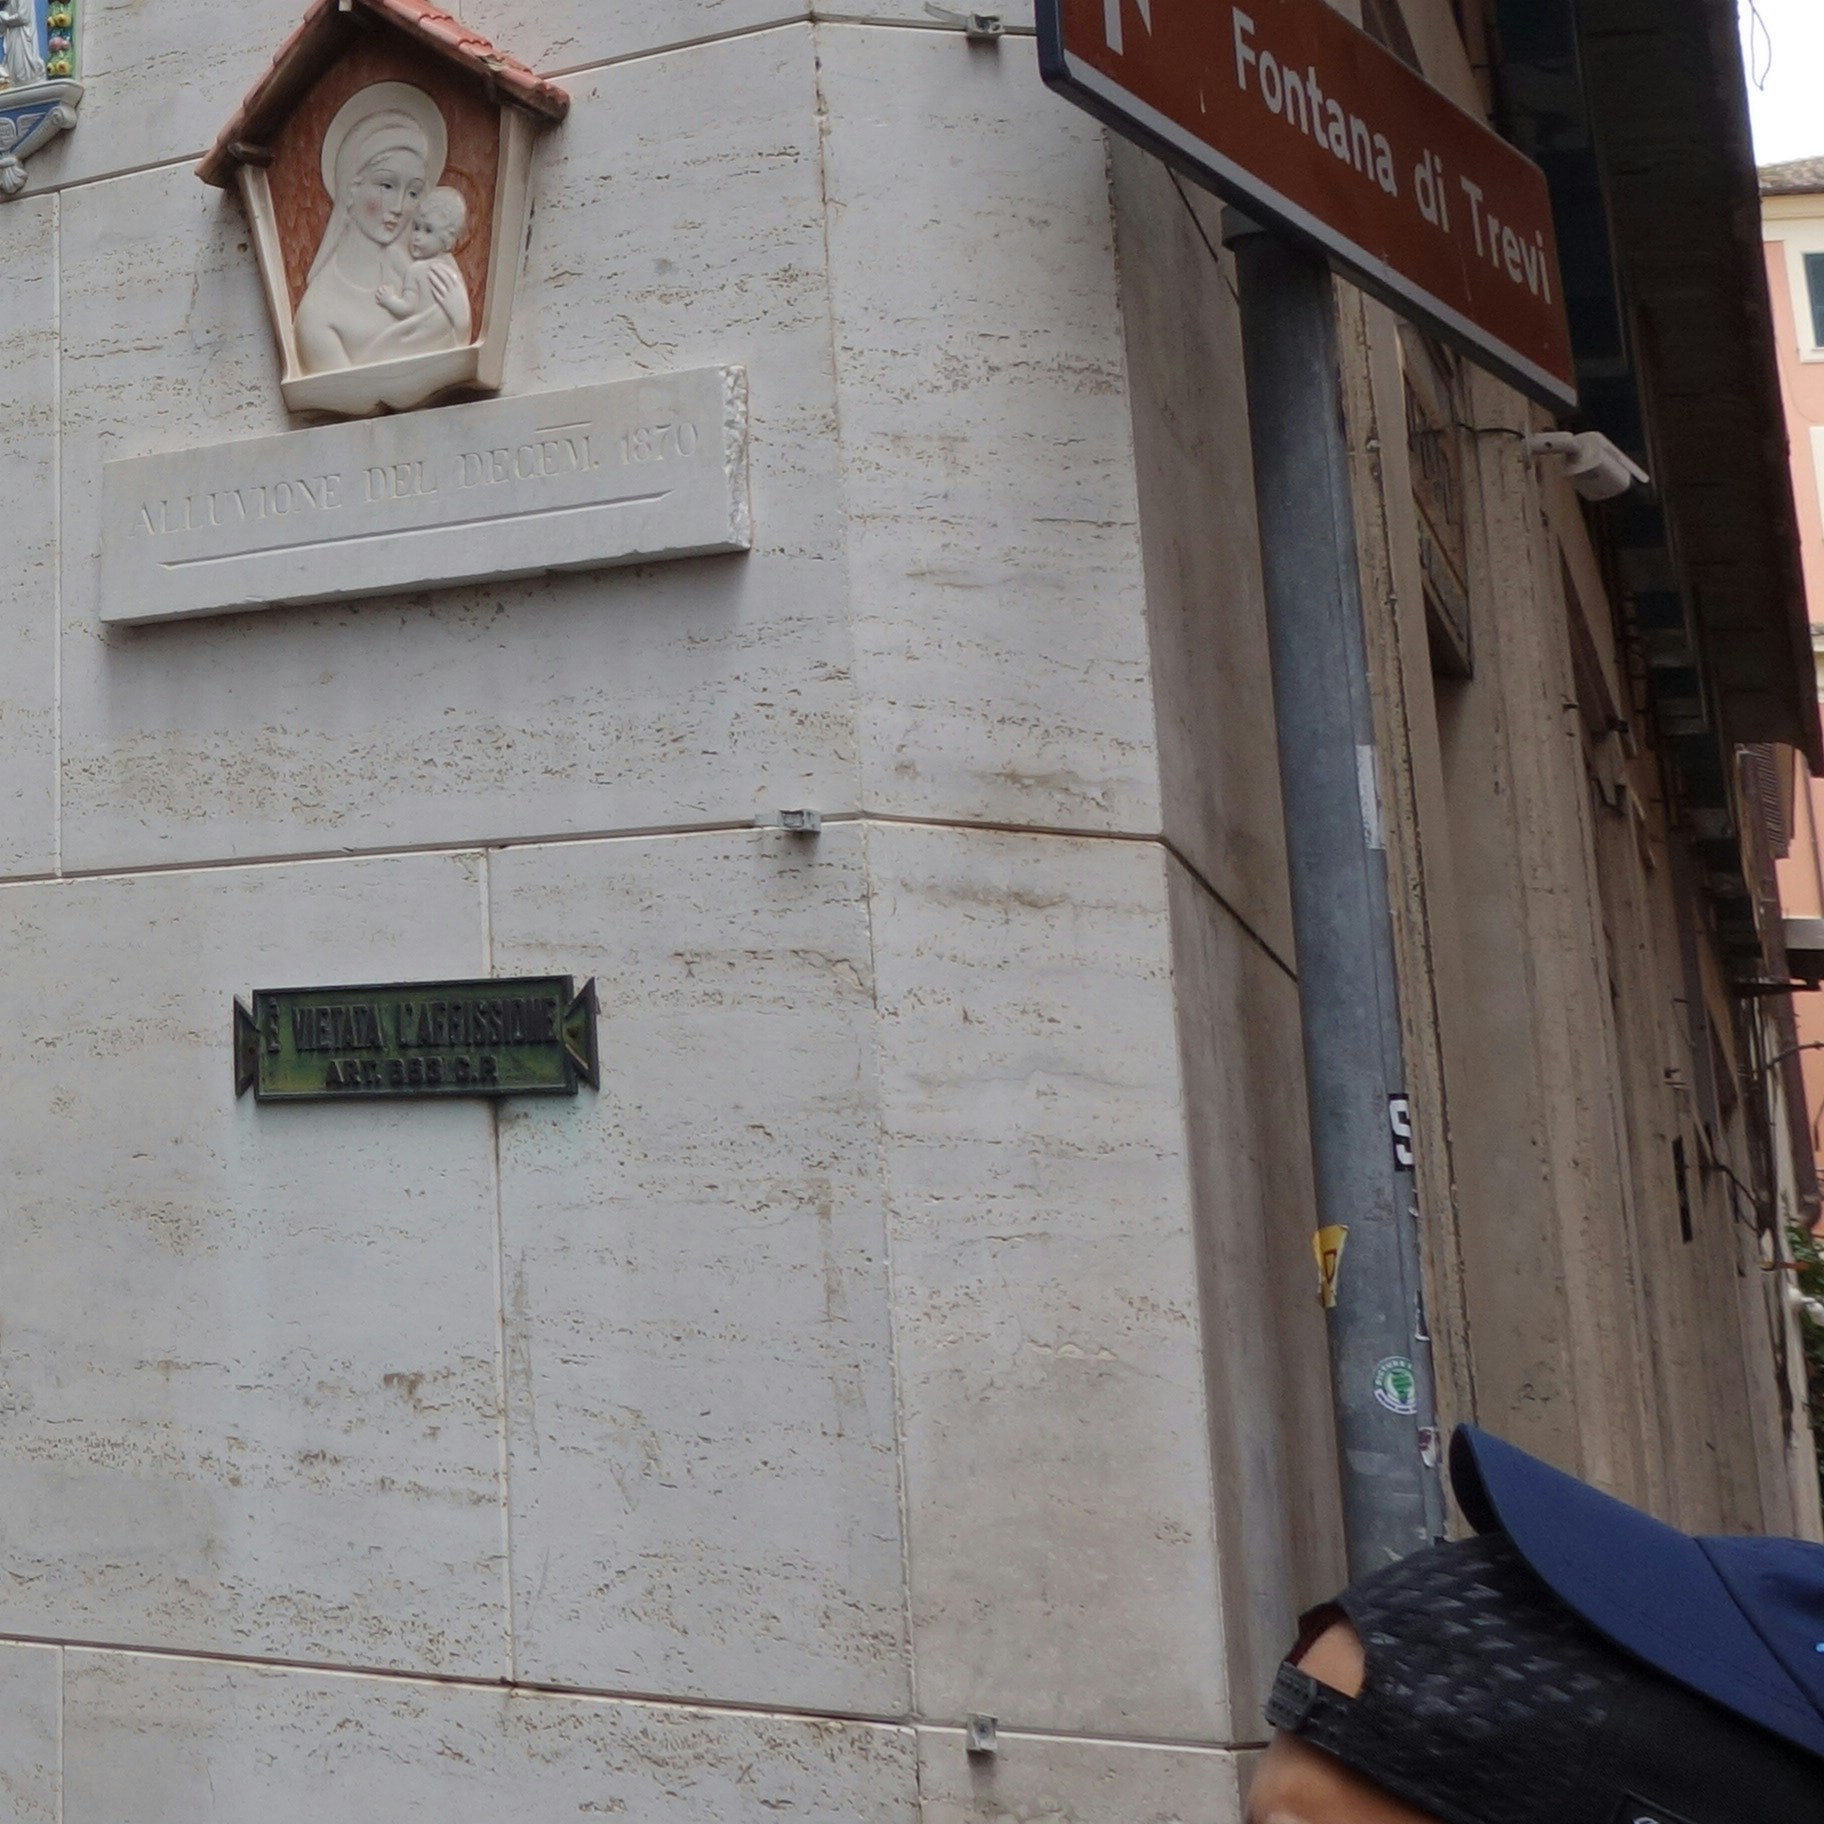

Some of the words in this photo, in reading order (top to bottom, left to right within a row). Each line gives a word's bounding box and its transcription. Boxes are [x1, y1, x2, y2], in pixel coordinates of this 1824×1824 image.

[1231, 6, 1398, 197] Fontana
[1414, 148, 1450, 233] di
[1460, 175, 1552, 305] Trevi
[128, 473, 343, 538] ALLUVIONE
[363, 460, 438, 503] DEL
[619, 420, 700, 467] 1870
[291, 1004, 384, 1051] VIETATA
[397, 994, 560, 1048] L'AFFISSIONE
